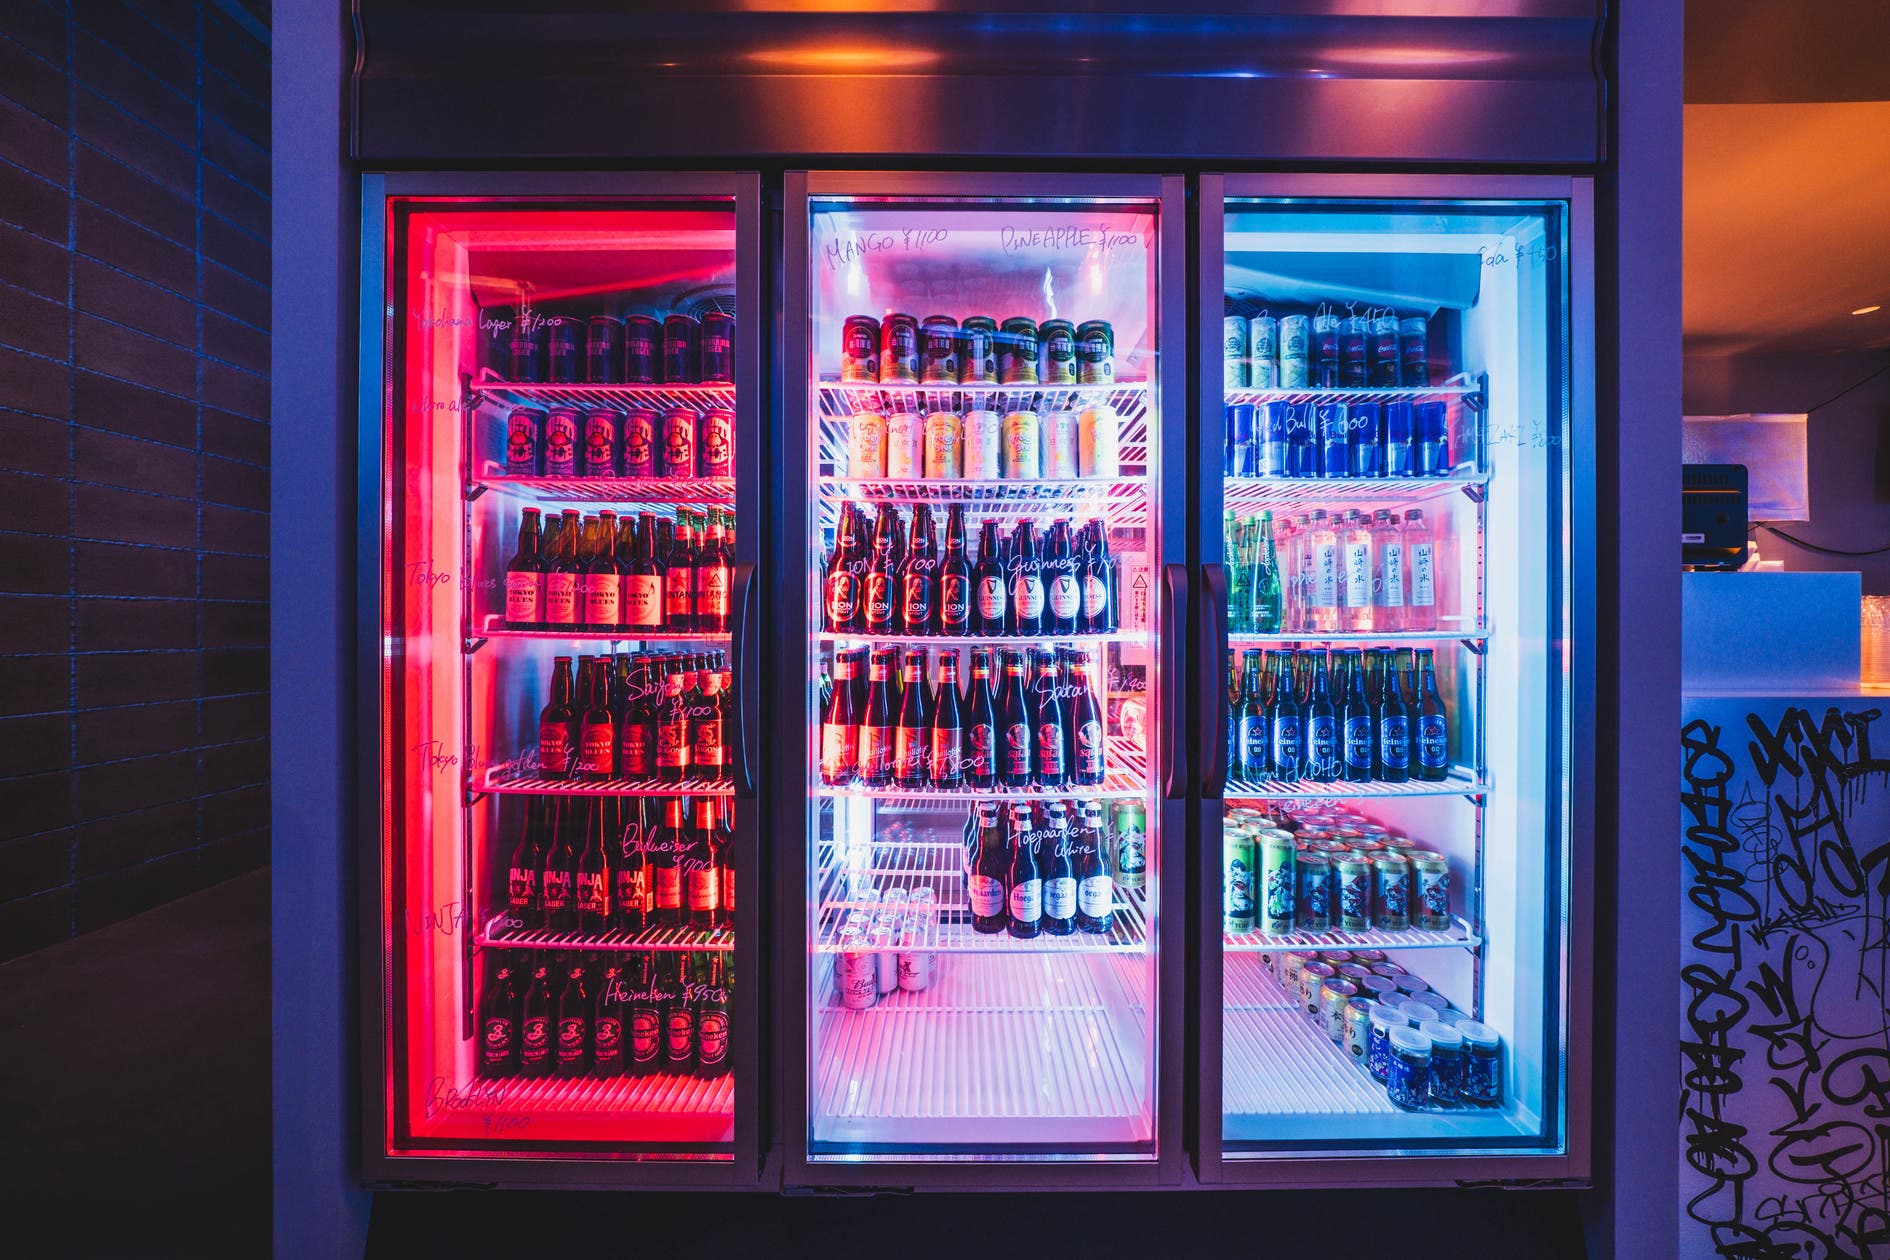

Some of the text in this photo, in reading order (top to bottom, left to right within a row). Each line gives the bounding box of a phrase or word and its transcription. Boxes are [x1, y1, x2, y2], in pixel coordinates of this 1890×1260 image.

[826, 233, 894, 270] MANGO
[478, 308, 513, 339] Lager
[1285, 405, 1317, 435] Bull
[1318, 409, 1369, 436] ¥600
[404, 561, 451, 589] Tokyo
[1007, 554, 1082, 596] Guinness
[625, 667, 681, 706] Saigon
[411, 740, 458, 775] Tokyo
[621, 822, 699, 858] Budweiser
[1006, 815, 1097, 854] Hoegaarden
[604, 973, 676, 1007] Heineken
